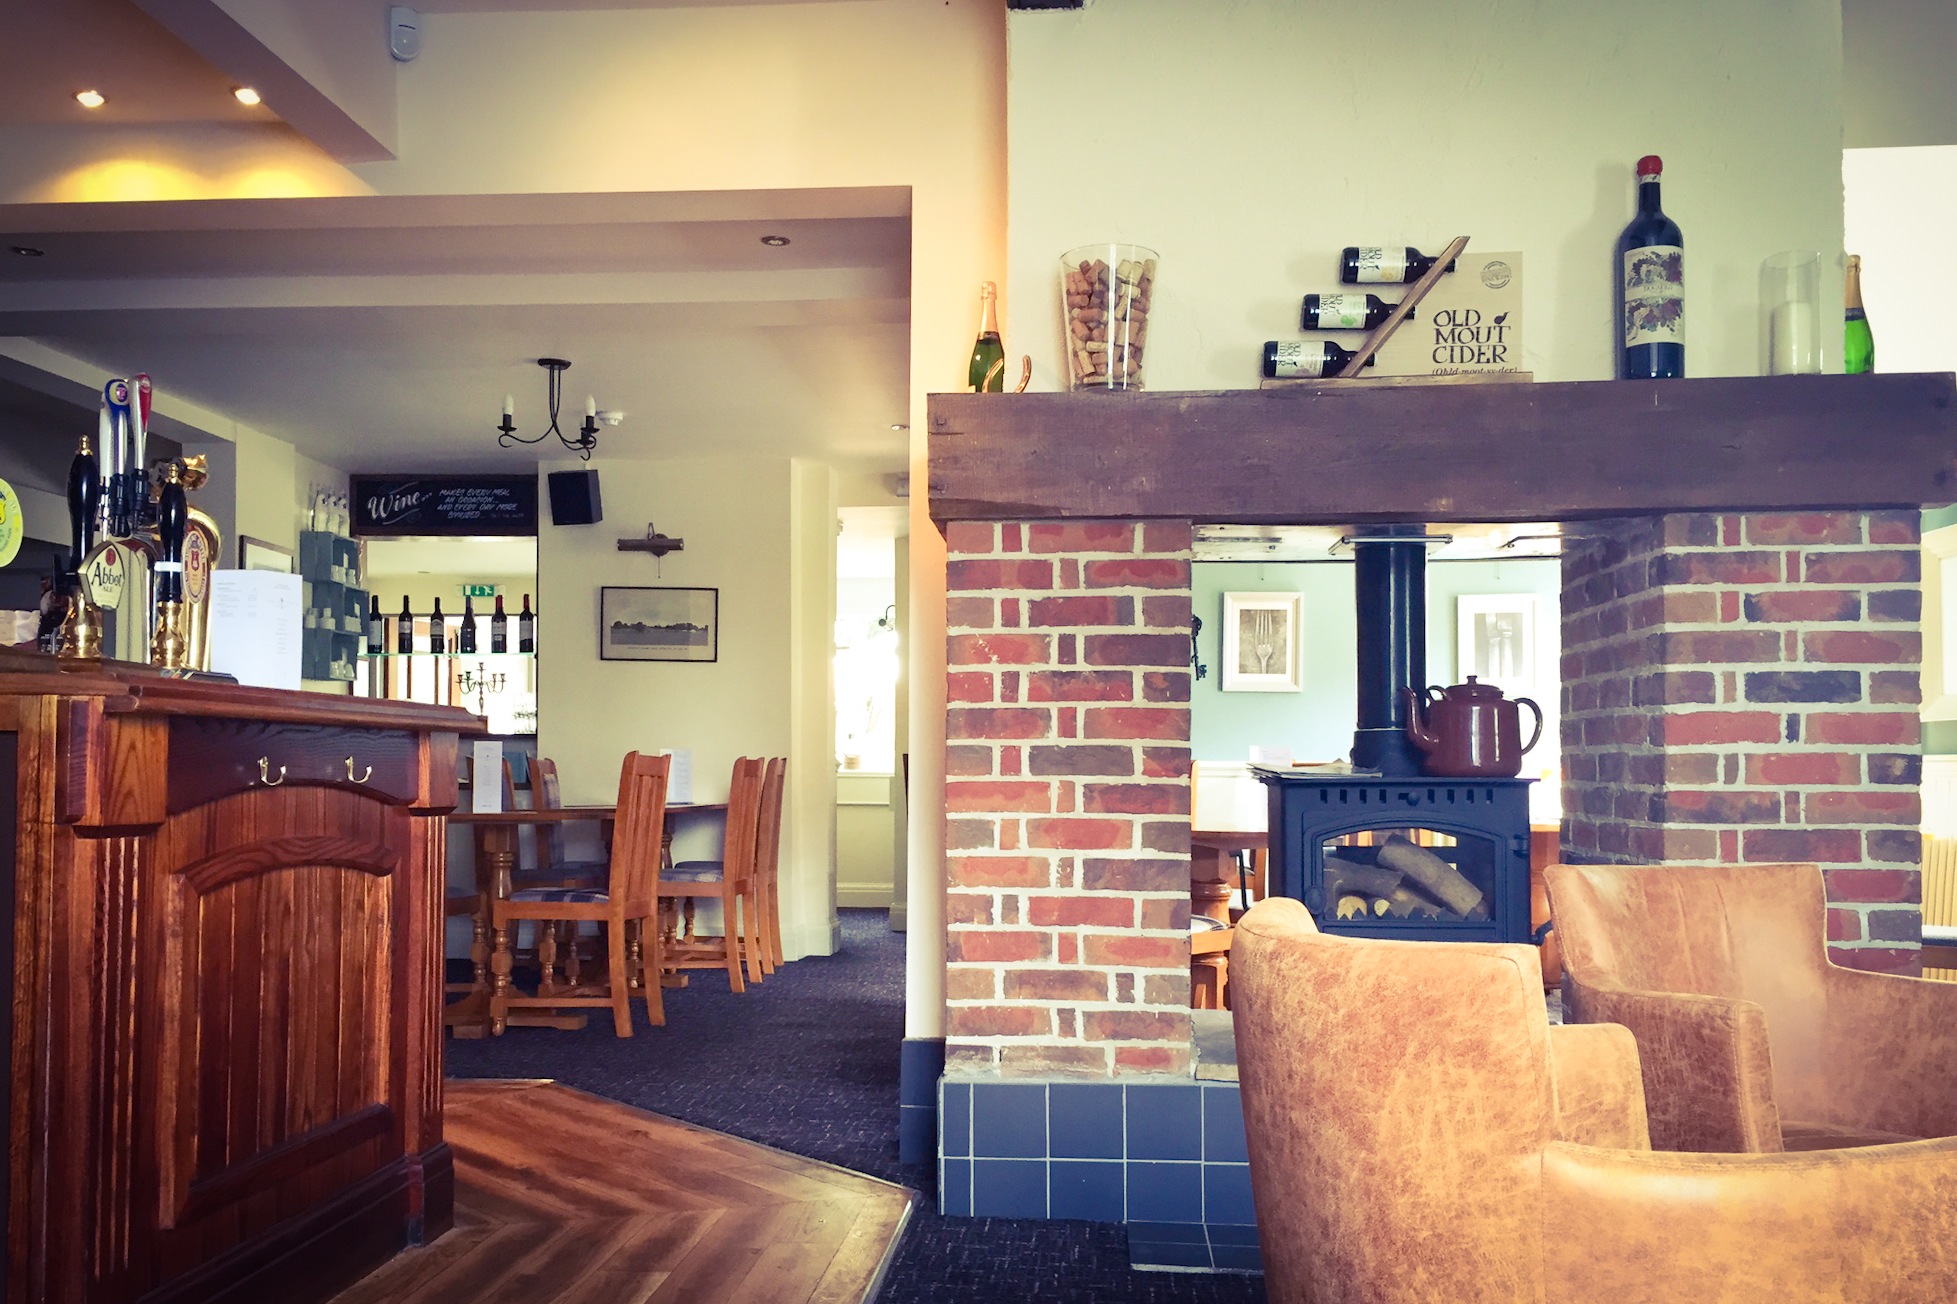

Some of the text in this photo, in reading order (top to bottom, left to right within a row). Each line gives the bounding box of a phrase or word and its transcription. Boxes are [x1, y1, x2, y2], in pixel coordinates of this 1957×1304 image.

[1433, 309, 1481, 327] OLD
[1434, 325, 1511, 344] MOUT
[1432, 344, 1508, 364] CIDER
[466, 487, 492, 496] EVERY
[492, 488, 510, 496] MEAL
[437, 503, 453, 511] AND
[454, 503, 477, 511] EVERY
[91, 561, 123, 587] Abbot
